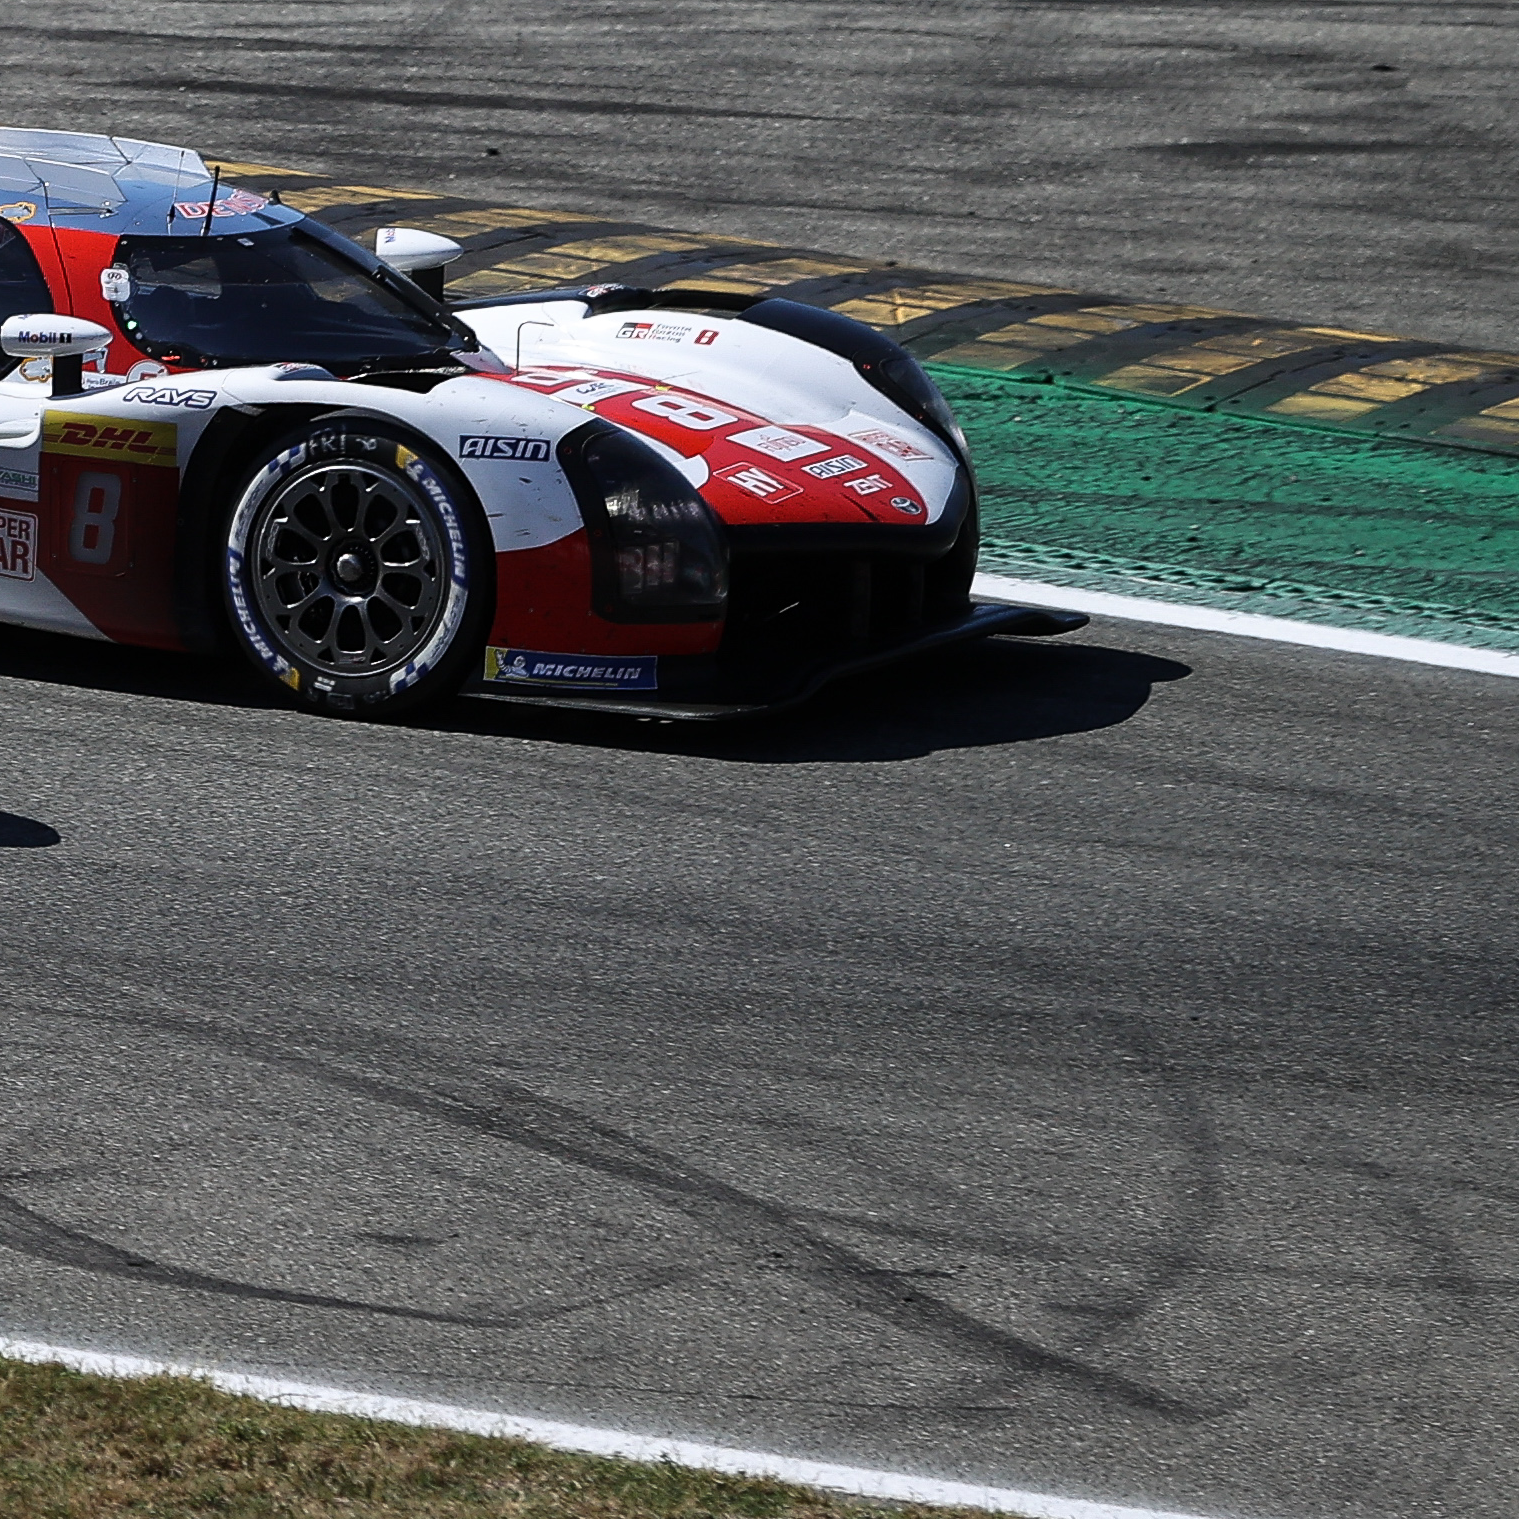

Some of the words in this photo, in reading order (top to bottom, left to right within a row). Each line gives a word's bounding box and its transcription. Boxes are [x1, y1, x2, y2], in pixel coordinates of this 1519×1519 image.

[18, 331, 57, 344] Mobil
[694, 329, 720, 346] 8
[123, 387, 217, 409] RAYS
[631, 394, 739, 431] 8
[61, 422, 159, 454] DHL
[461, 438, 548, 459] AISIN
[809, 457, 862, 477] AISIN
[68, 470, 121, 564] 8
[422, 478, 466, 580] MICHELIN
[230, 561, 274, 661] MICHELIN
[532, 663, 641, 680] MICHELIN
